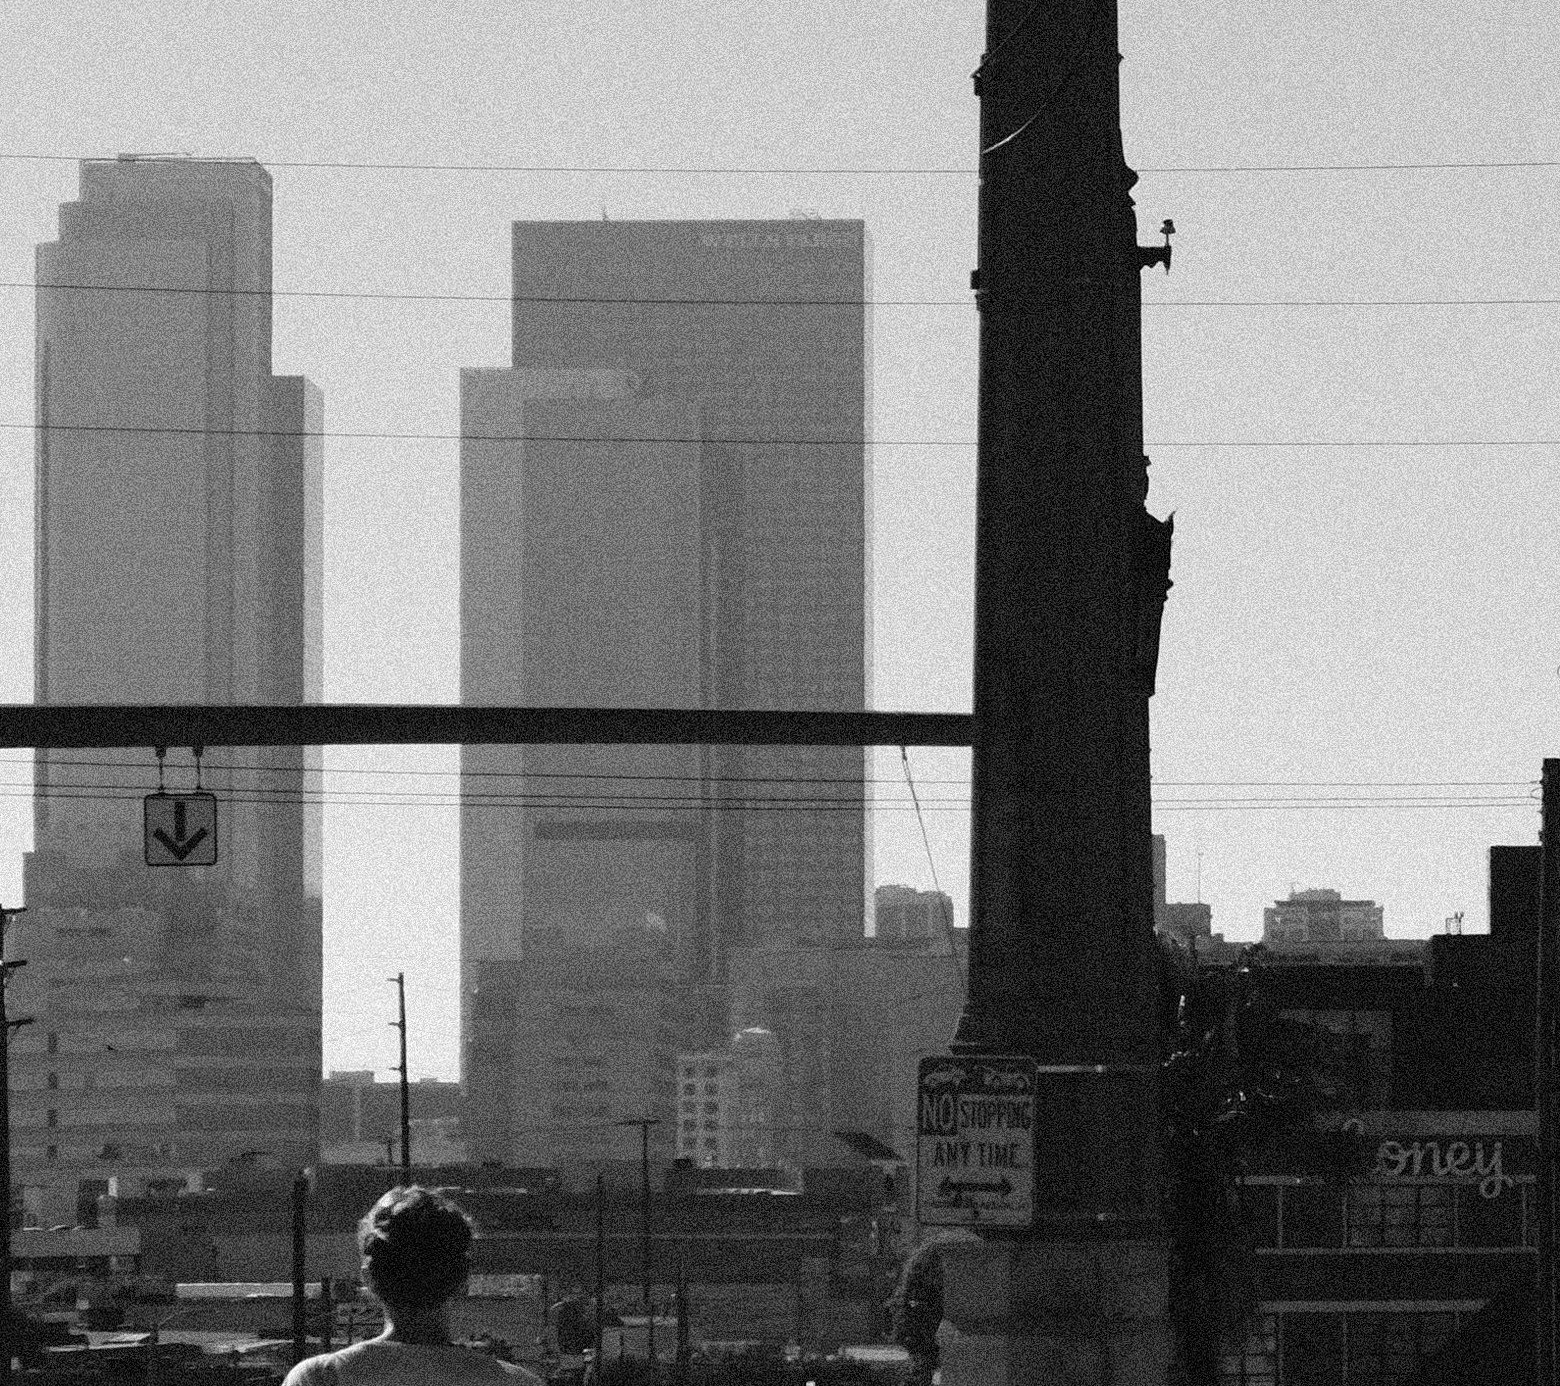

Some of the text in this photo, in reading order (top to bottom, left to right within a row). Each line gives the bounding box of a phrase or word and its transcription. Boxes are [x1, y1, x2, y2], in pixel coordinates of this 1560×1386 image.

[922, 1093, 1031, 1131] NO STOPPING
[933, 1142, 1020, 1168] ANY TIME
